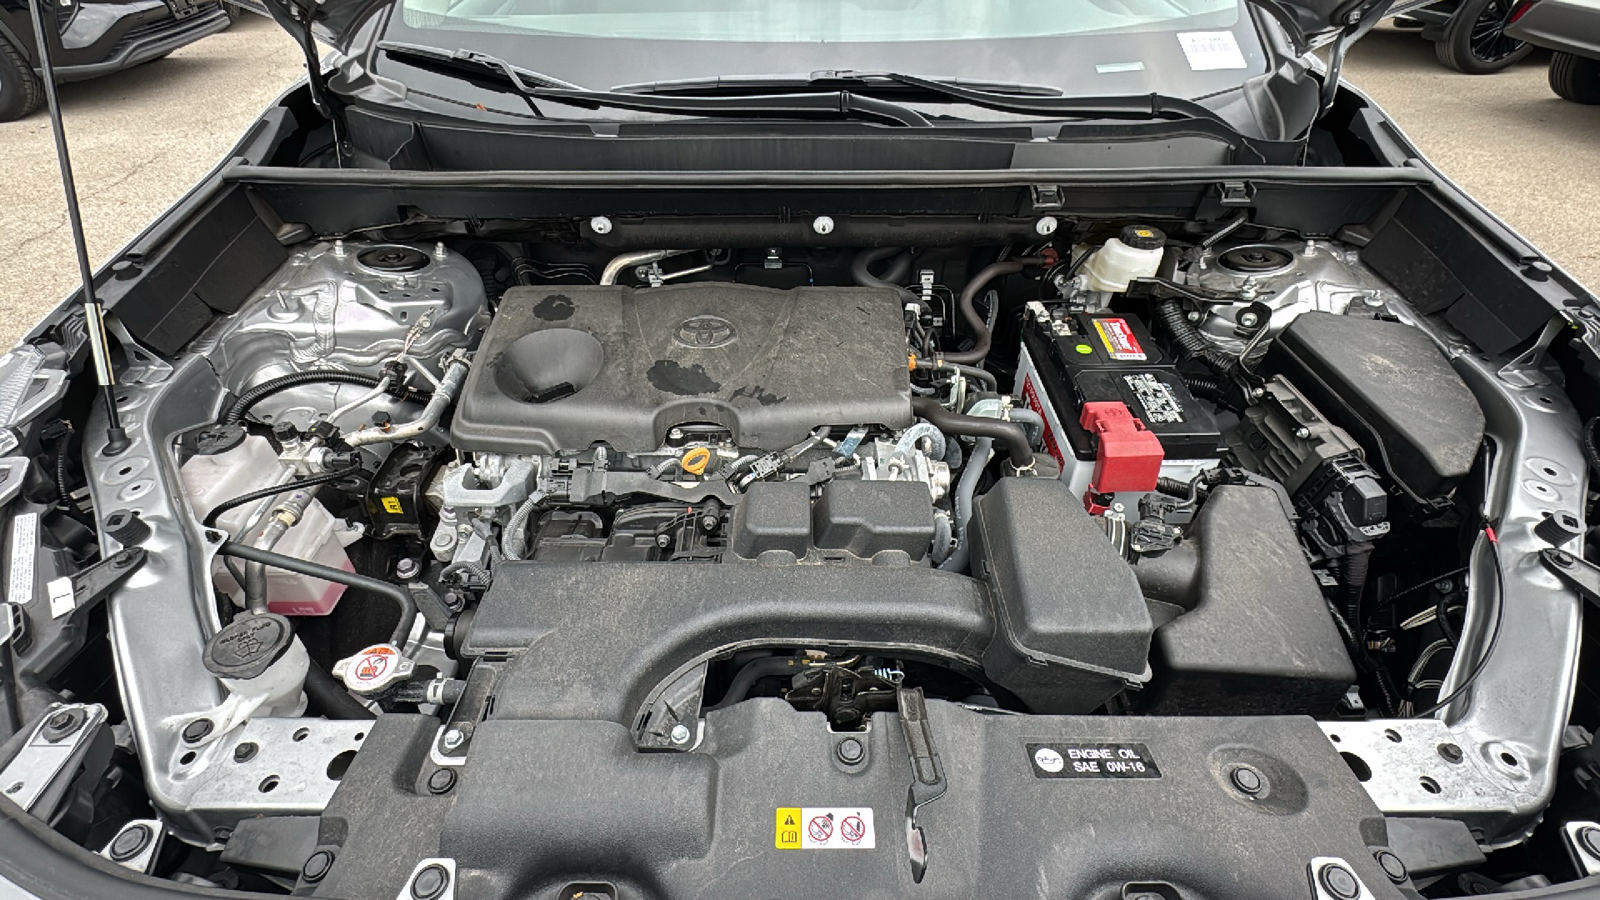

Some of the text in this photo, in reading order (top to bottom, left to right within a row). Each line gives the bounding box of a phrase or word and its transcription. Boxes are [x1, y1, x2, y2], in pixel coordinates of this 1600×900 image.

[1067, 748, 1141, 759] ENGINE OIL
[1073, 761, 1146, 773] SAE 0W-16
